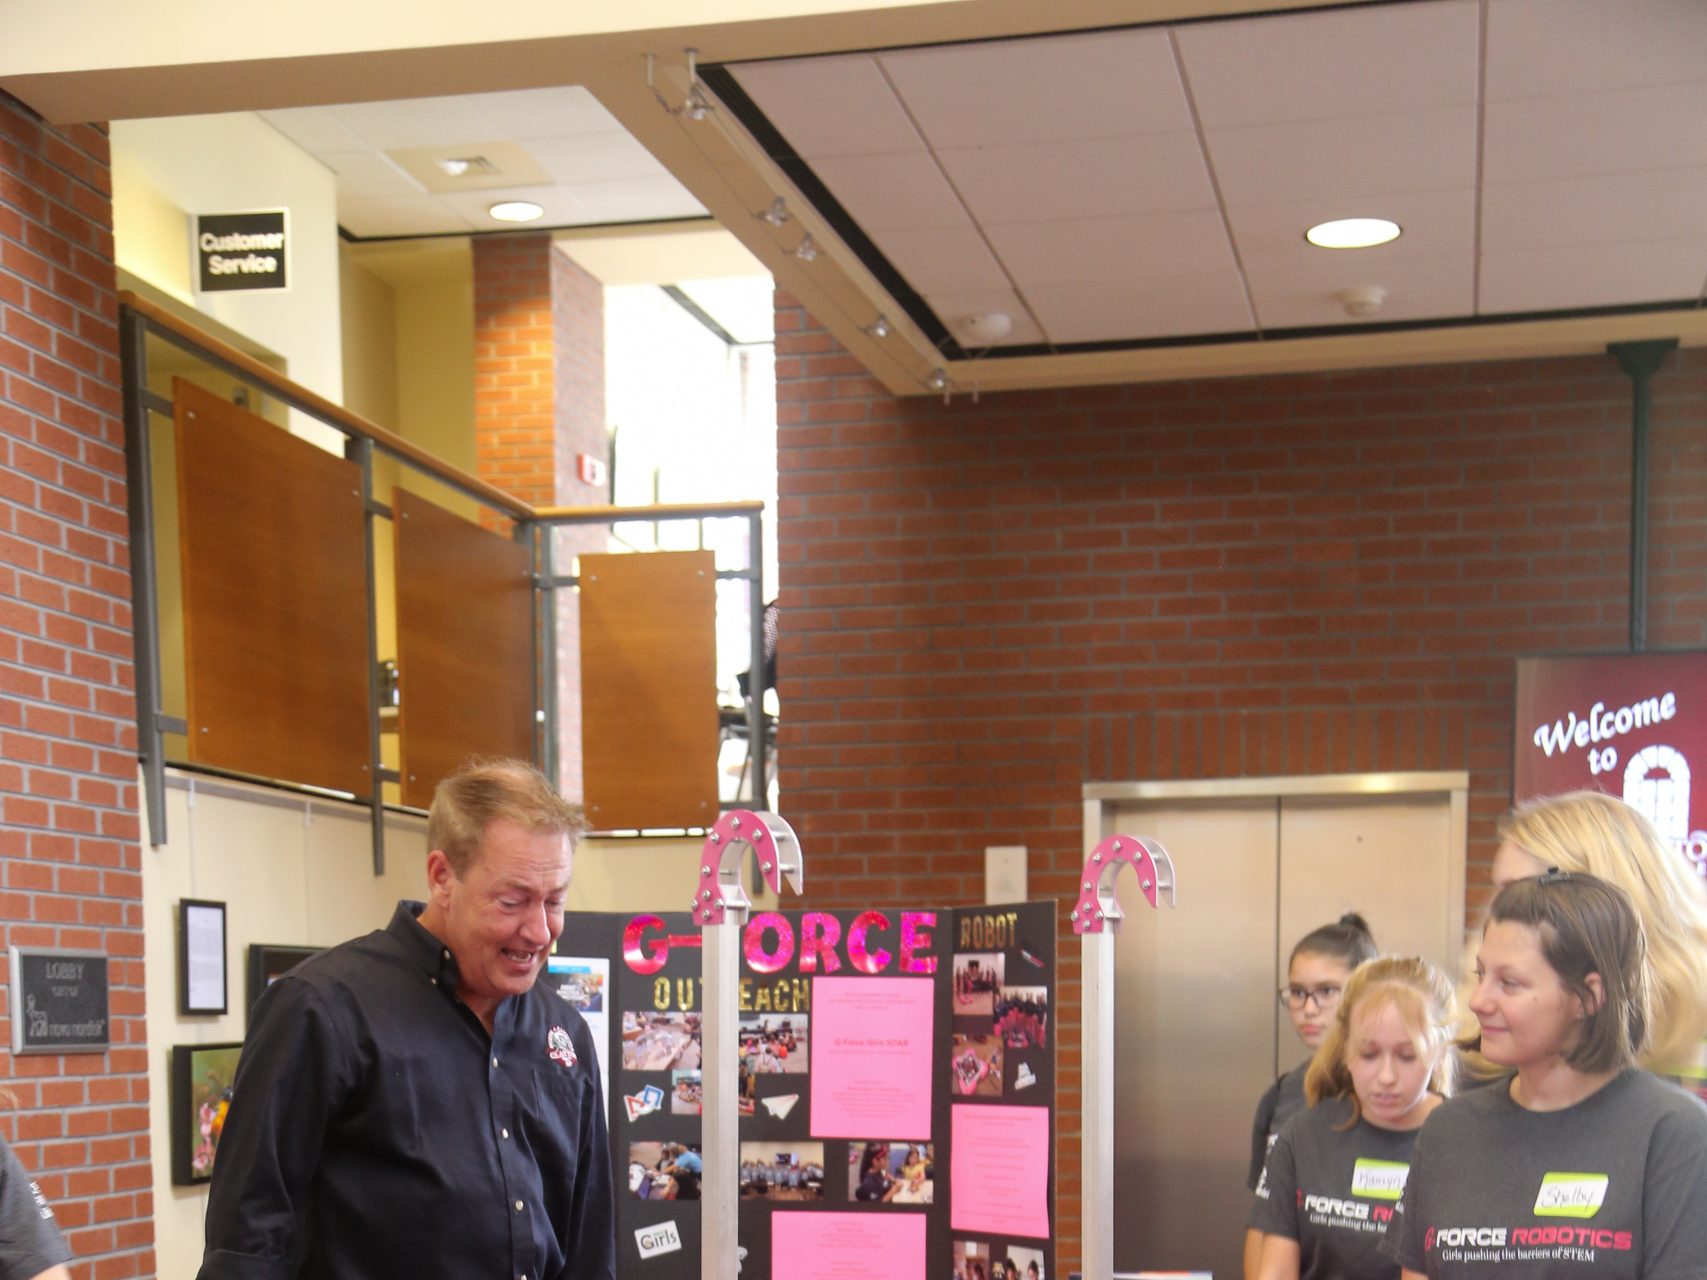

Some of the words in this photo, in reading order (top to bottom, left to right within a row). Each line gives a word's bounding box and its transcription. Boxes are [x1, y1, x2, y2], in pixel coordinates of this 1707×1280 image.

[200, 232, 284, 252] Customer
[208, 253, 277, 275] Service
[1533, 692, 1677, 758] Welcome
[1587, 746, 1618, 775] to
[623, 909, 938, 975] G-ORCE
[961, 911, 1018, 949] ROBOT
[46, 962, 85, 979] LOBBY
[653, 975, 810, 1012] OUEACH
[640, 1229, 677, 1250] Girls
[1512, 1226, 1632, 1250] ROBOTICS
[1442, 1248, 1462, 1261] Girls
[1464, 1248, 1500, 1263] pushing
[1501, 1247, 1516, 1260] the
[1518, 1247, 1550, 1260] barriers
[1552, 1245, 1564, 1260] of
[1563, 1247, 1595, 1262] STEM
